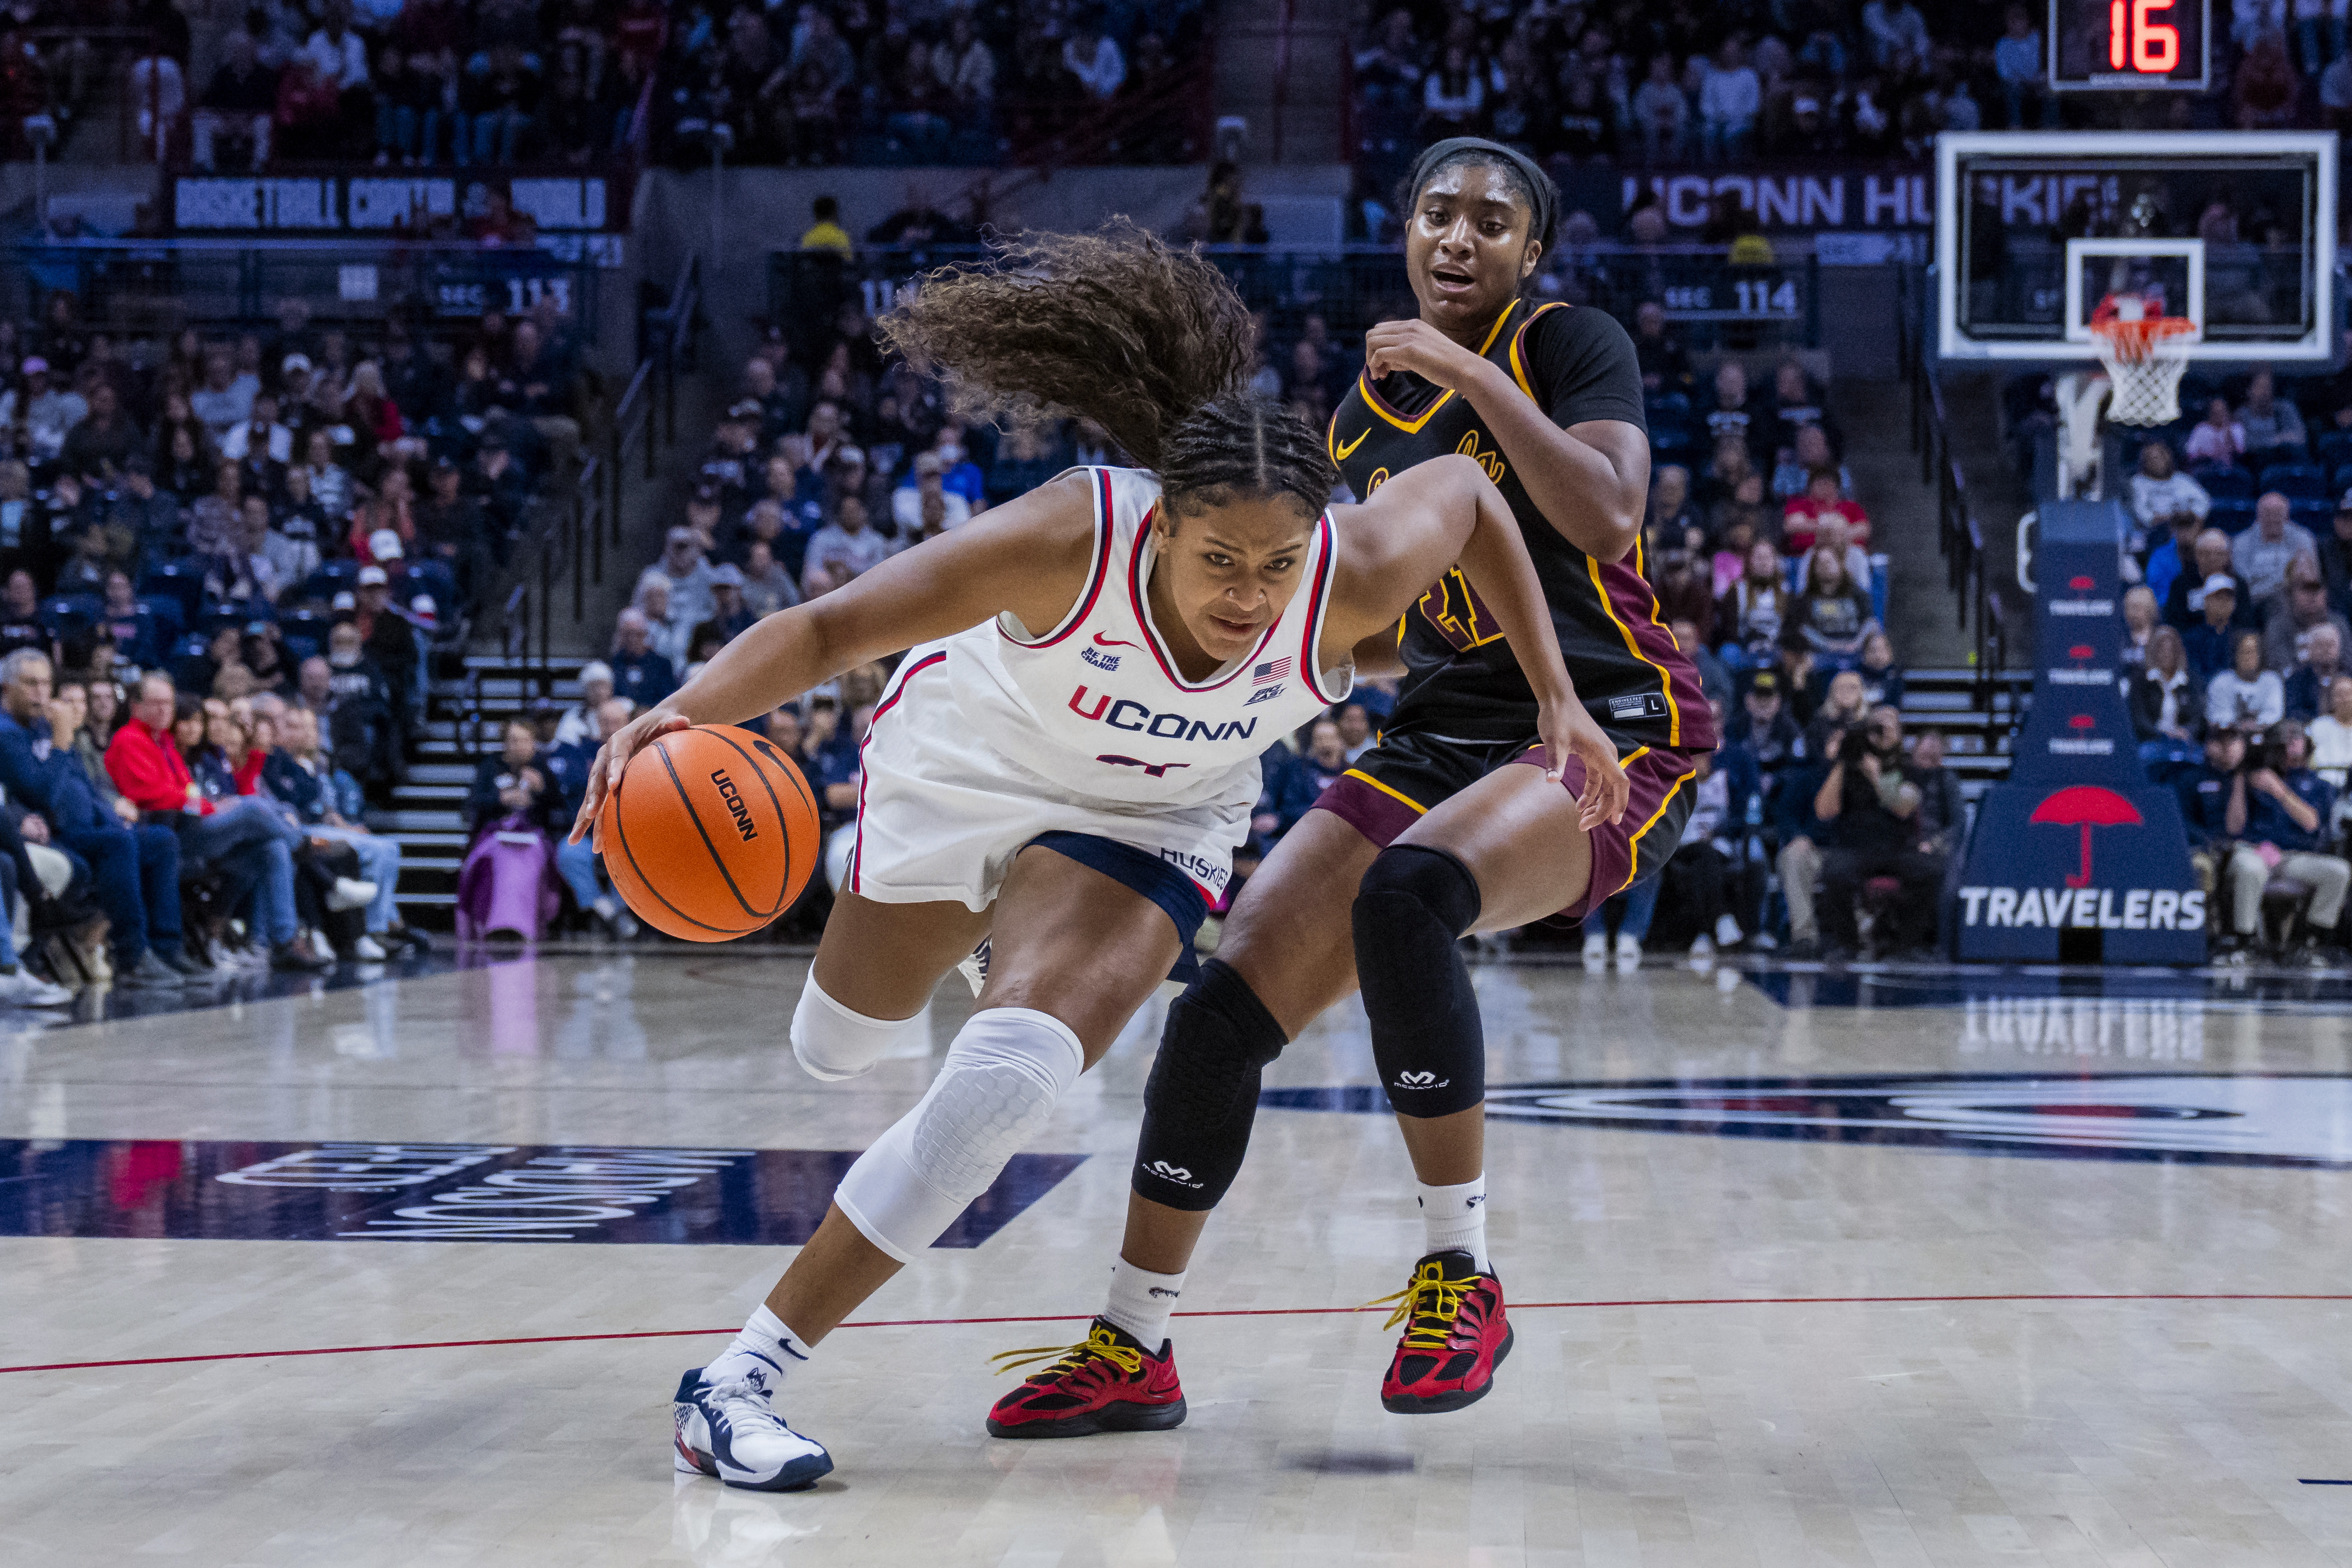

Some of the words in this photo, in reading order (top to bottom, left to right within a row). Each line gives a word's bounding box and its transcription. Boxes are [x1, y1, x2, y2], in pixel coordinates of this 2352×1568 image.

[2110, 0, 2179, 72] 16
[1737, 280, 1807, 318] 114
[1080, 650, 1119, 672] CHANGE
[1085, 646, 1101, 659] BE
[1101, 654, 1122, 665] THE
[1253, 683, 1284, 697] BIG
[1651, 699, 1659, 710] L
[1068, 684, 1258, 741] UCONN
[710, 768, 759, 842] UCONN
[1160, 847, 1228, 890] HUSKIES
[1958, 886, 2208, 930] TRAVELERS
